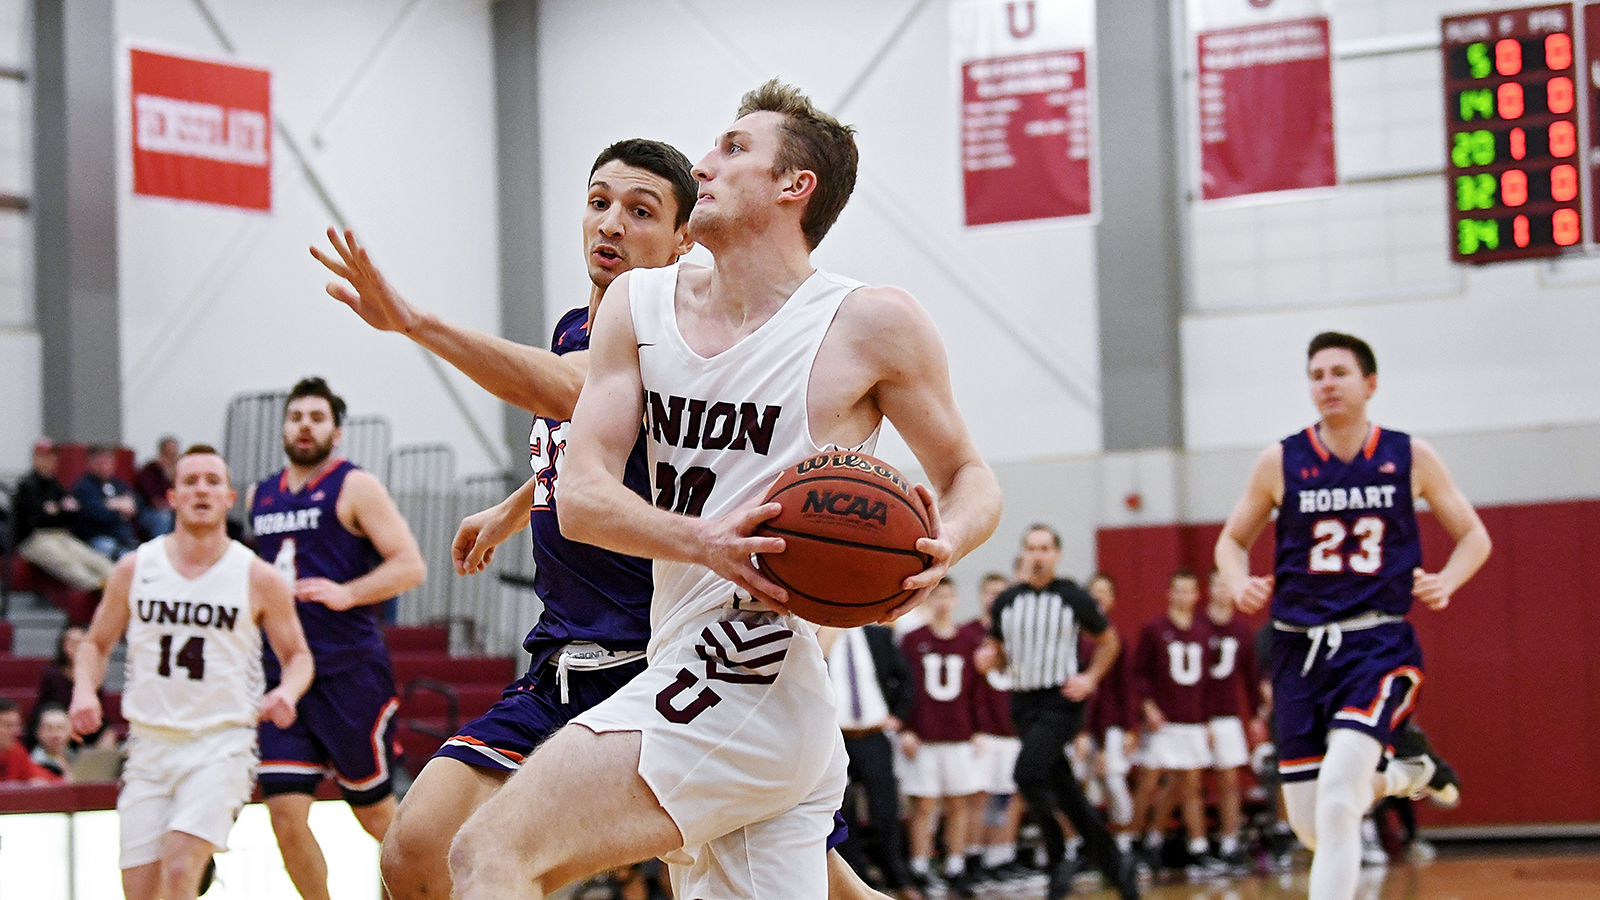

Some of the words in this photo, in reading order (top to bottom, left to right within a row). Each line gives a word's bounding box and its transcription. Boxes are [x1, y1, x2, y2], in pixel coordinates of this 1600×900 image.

[1005, 0, 1035, 39] U
[1495, 38, 1522, 76] 0
[1544, 33, 1572, 71] 0
[1497, 82, 1524, 119] 0
[1546, 76, 1574, 114] 0
[1509, 127, 1526, 160] 1
[1548, 120, 1576, 158] 0
[1500, 169, 1528, 207] 0
[1550, 164, 1578, 202] 0
[1513, 214, 1530, 248] 1
[1552, 208, 1580, 246] 0
[645, 389, 783, 457] NION
[796, 454, 909, 496] Wilson
[801, 490, 888, 526] NCAA
[1299, 485, 1396, 513] HOBART
[254, 507, 322, 536] HOBART
[1309, 516, 1386, 575] 23
[138, 600, 239, 631] UNION
[157, 635, 205, 680] 14
[922, 653, 965, 701] U
[1167, 641, 1203, 686] U
[655, 666, 723, 725] U
